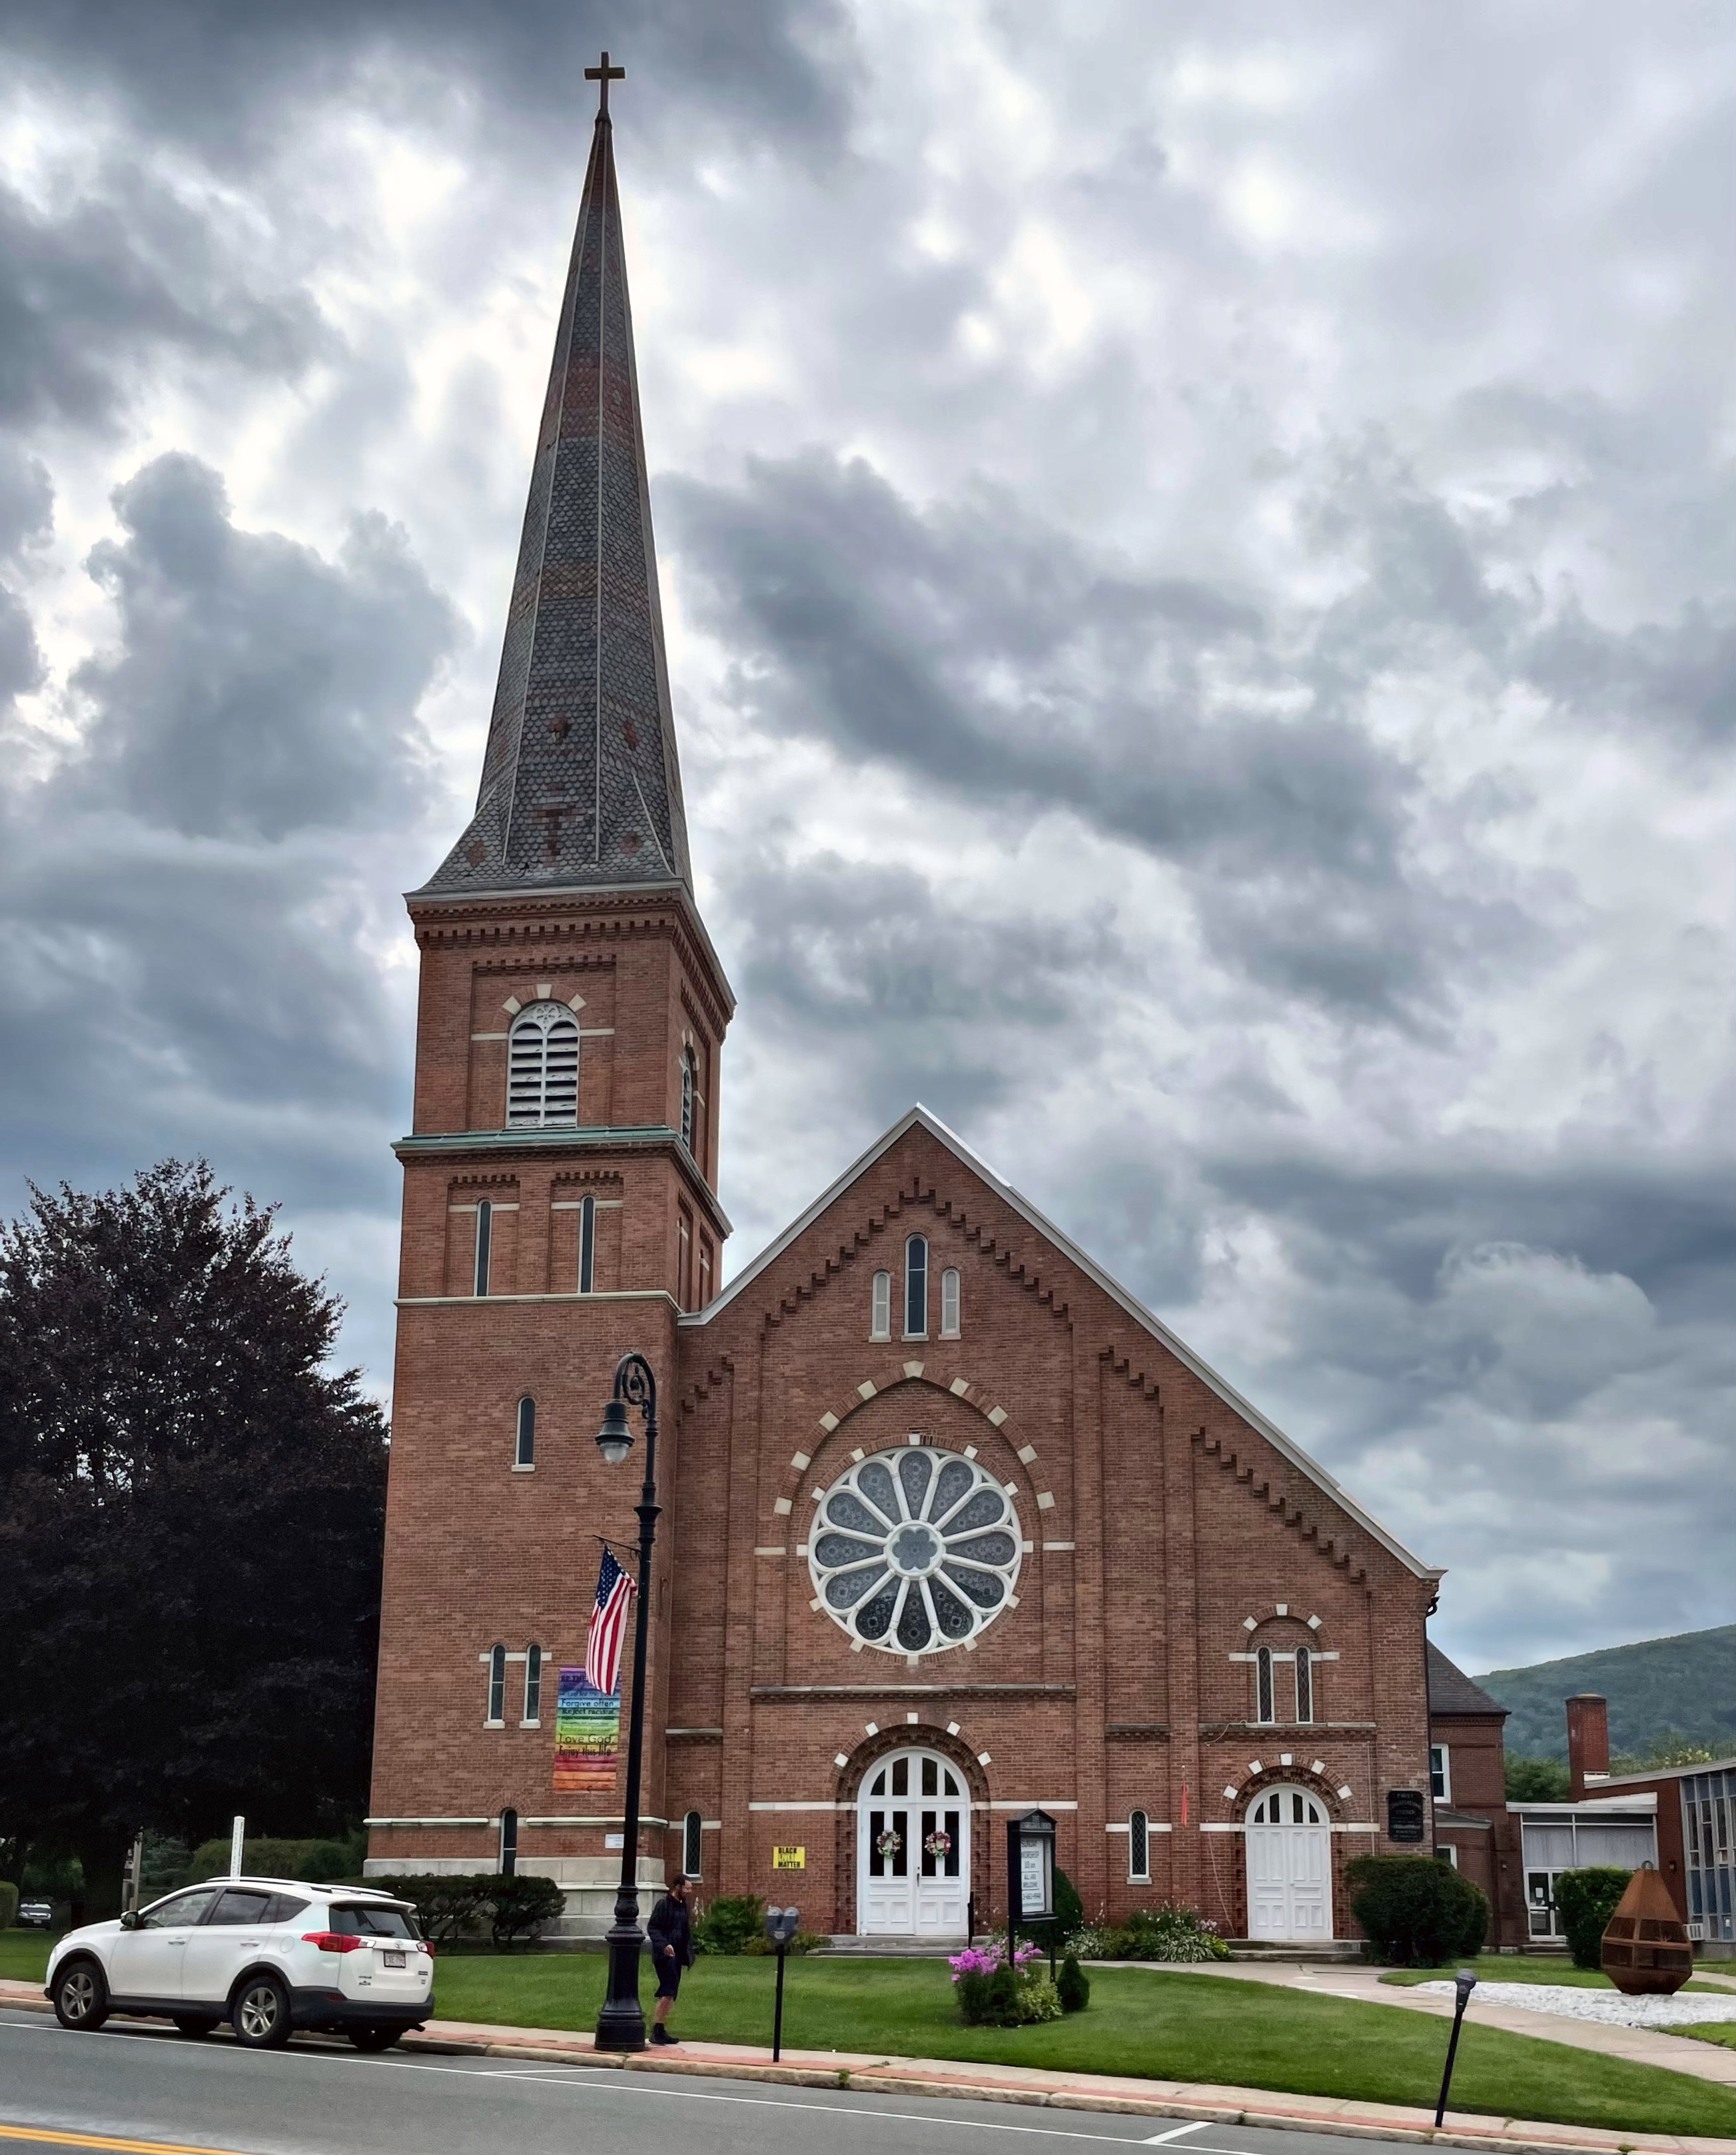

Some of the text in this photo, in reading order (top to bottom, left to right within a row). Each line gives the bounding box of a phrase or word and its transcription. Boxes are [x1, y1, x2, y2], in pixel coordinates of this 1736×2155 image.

[562, 1698, 591, 1708] Forgive
[560, 1733, 614, 1743] Love God.
[560, 1745, 580, 1758] Enjoy
[582, 1745, 596, 1756] this
